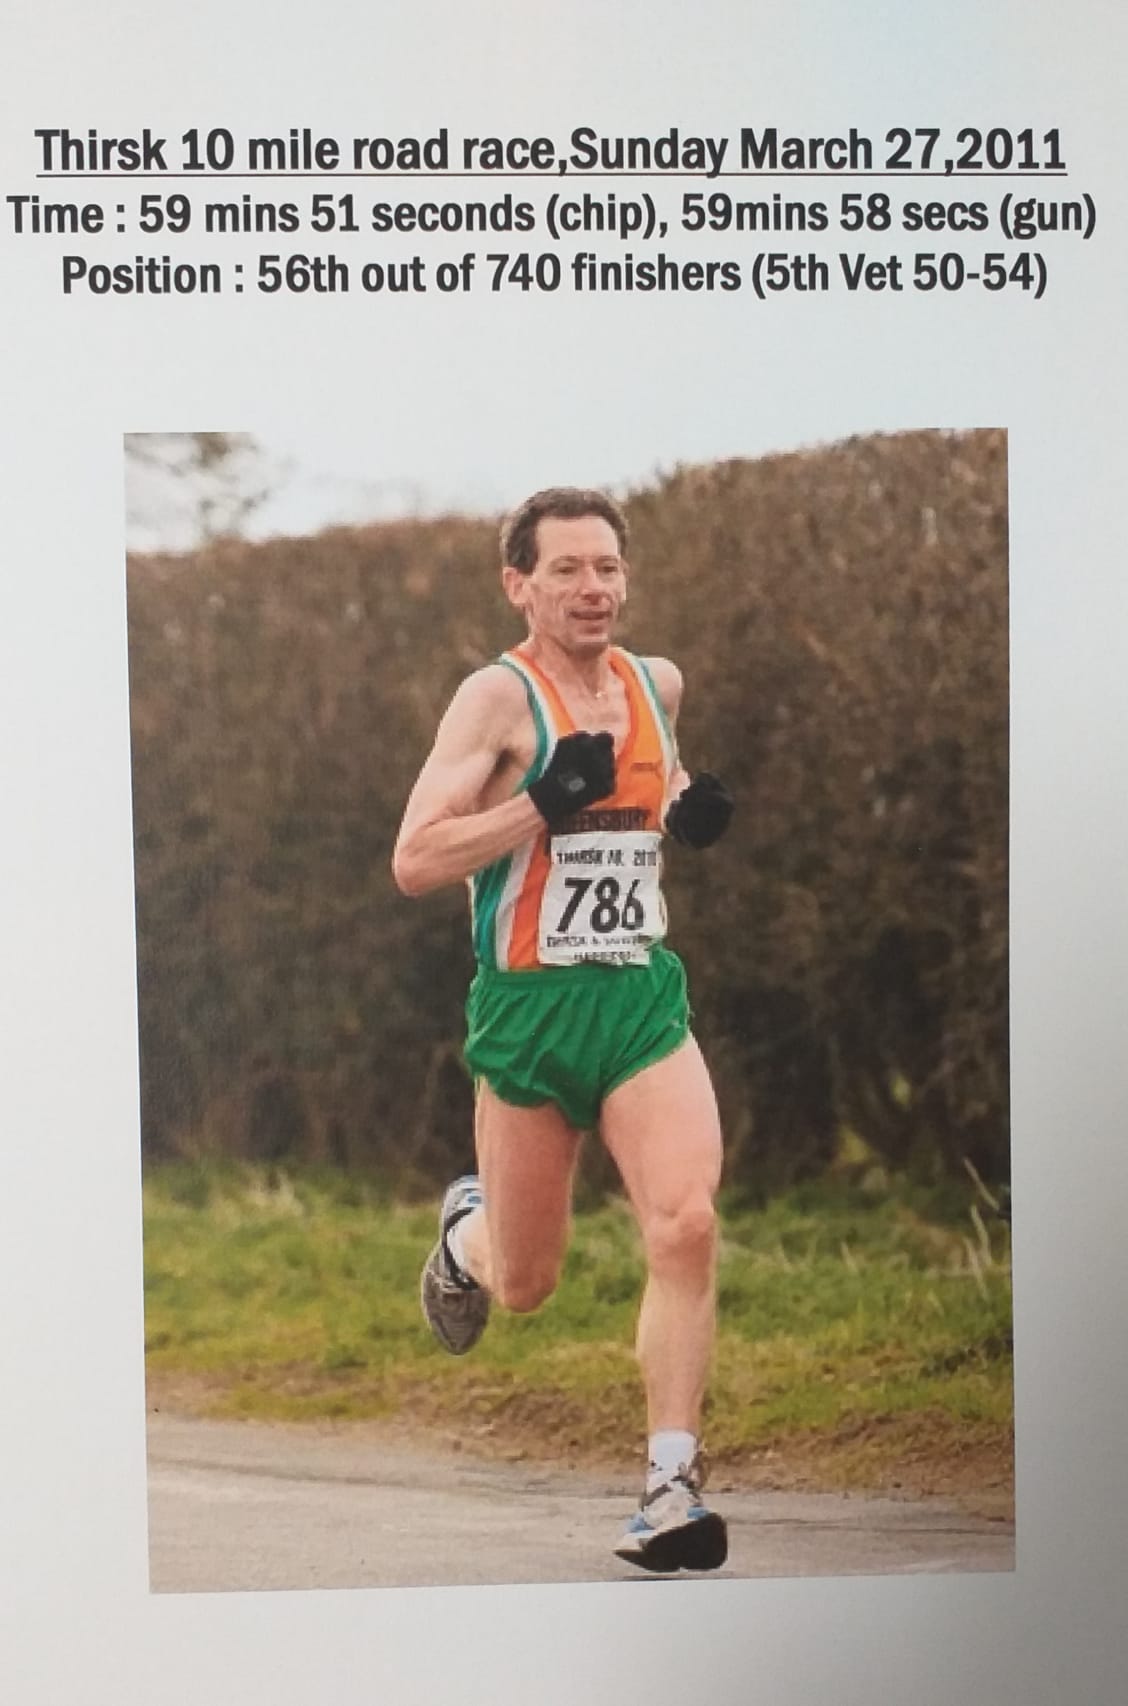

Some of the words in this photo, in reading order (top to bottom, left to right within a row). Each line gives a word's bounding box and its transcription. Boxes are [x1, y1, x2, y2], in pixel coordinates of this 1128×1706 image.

[35, 129, 167, 170] Thirsk
[183, 129, 234, 170] 10
[249, 129, 339, 169] mile
[354, 129, 448, 170] road
[464, 128, 728, 177] race,Sunday
[742, 128, 872, 169] March
[886, 128, 1066, 176] 27,2011
[7, 195, 103, 233] Time
[139, 194, 190, 232] 59
[206, 194, 299, 232] mins
[311, 194, 359, 232] 51
[373, 194, 535, 232] seconds
[547, 193, 667, 239] (chip),
[682, 193, 828, 231] 59mins
[840, 193, 891, 231] 58
[903, 202, 988, 231] secs
[1000, 194, 1096, 240] (gun)
[63, 255, 220, 293] Position
[258, 255, 348, 293] 56th
[362, 256, 426, 292] out
[437, 254, 476, 292] of
[487, 254, 560, 291] 740
[572, 253, 741, 291] finishers
[753, 253, 828, 299] (5th
[840, 253, 903, 291] Vet
[914, 253, 1047, 298] 50-54)
[556, 877, 644, 932] 786
